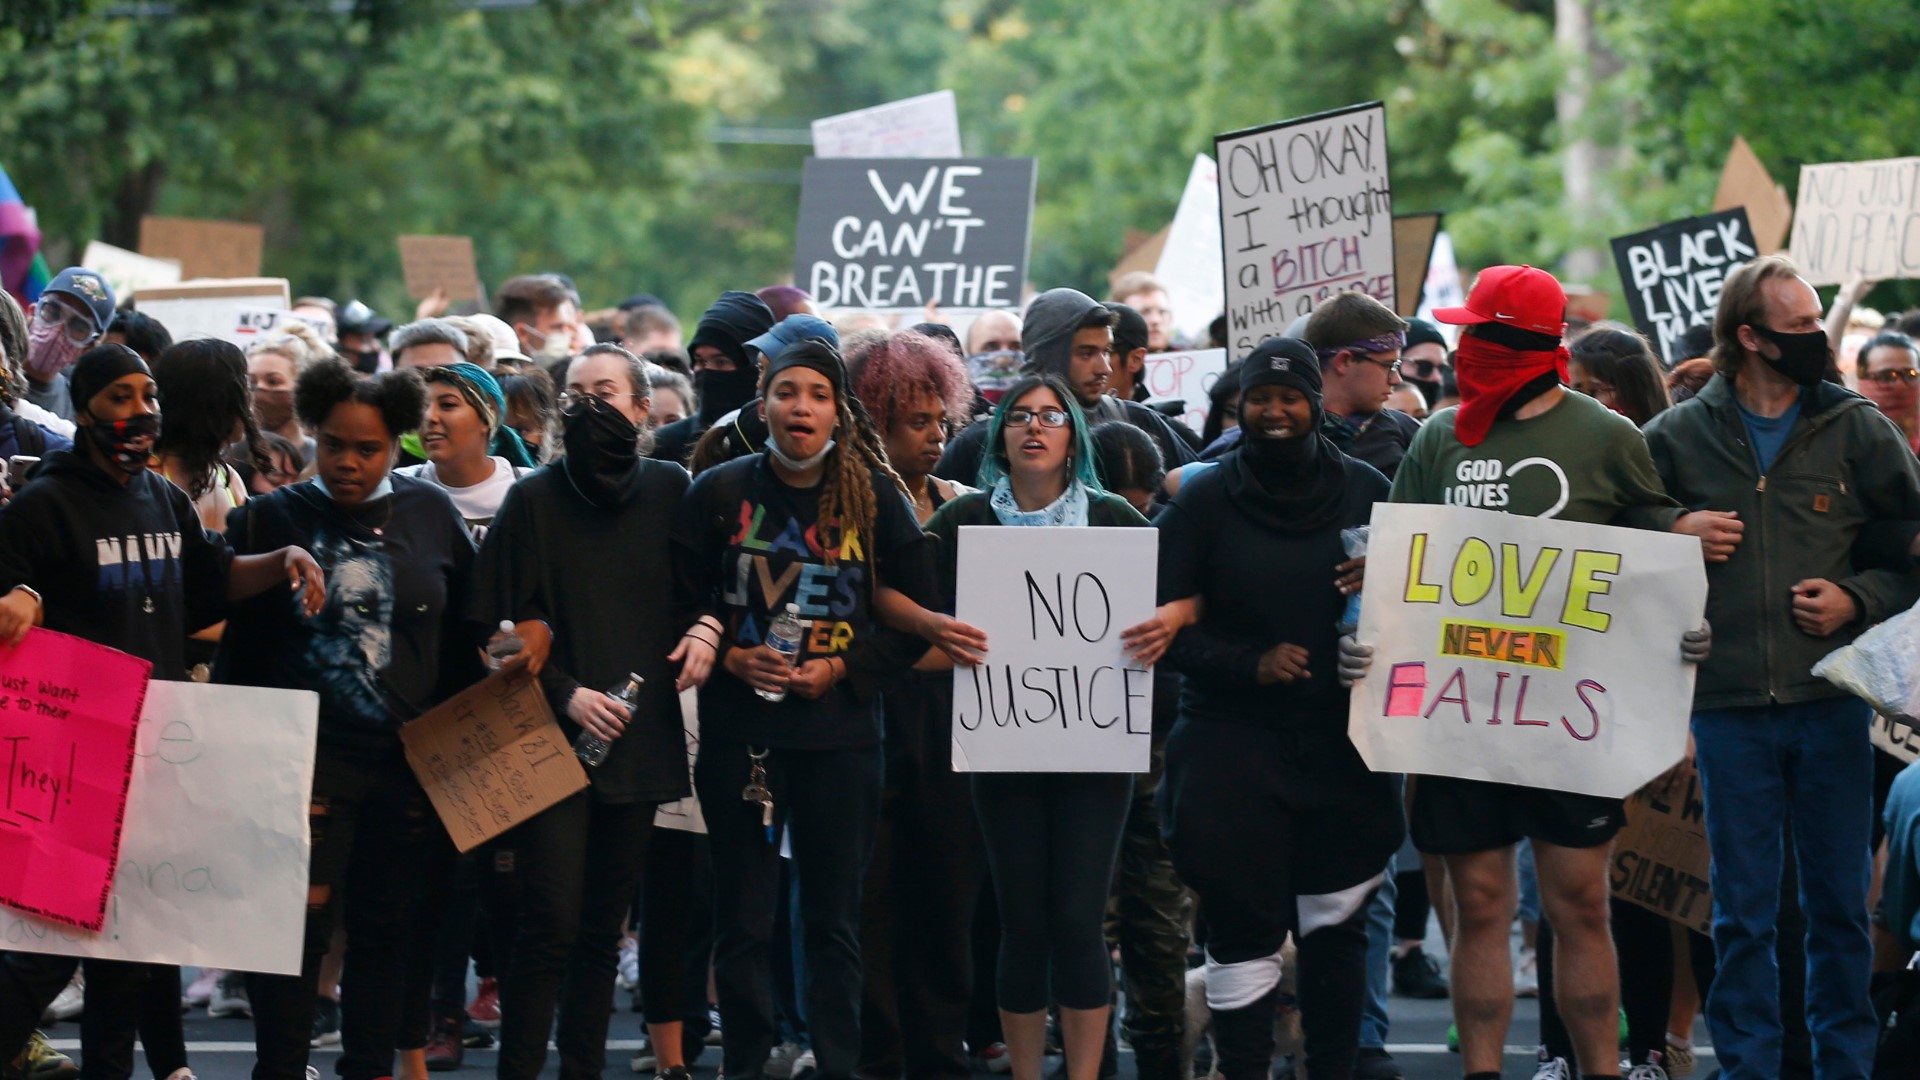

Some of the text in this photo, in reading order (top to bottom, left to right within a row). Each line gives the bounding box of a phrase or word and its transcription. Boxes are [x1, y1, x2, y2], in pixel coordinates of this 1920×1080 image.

[867, 166, 983, 215] WE
[1229, 144, 1283, 199] OH
[1804, 166, 1847, 209] NO
[832, 216, 985, 259] CAN'T
[1233, 176, 1391, 252] I thought
[1239, 235, 1363, 290] a BITCH
[1627, 218, 1755, 290] BLACK
[1799, 211, 1840, 273] NO
[811, 261, 1015, 308] BREATHE
[1296, 294, 1312, 317] a
[1444, 483, 1509, 507] LOVES
[1456, 459, 1502, 481] GOD
[96, 532, 182, 588] NAVY
[722, 552, 864, 617] IVES
[1404, 533, 1621, 633] LOVE
[1025, 570, 1111, 643] NO
[1442, 623, 1560, 669] NEVER
[959, 664, 1151, 735] JUSTICE
[1383, 661, 1607, 741] FAILS
[4, 737, 76, 823] They!
